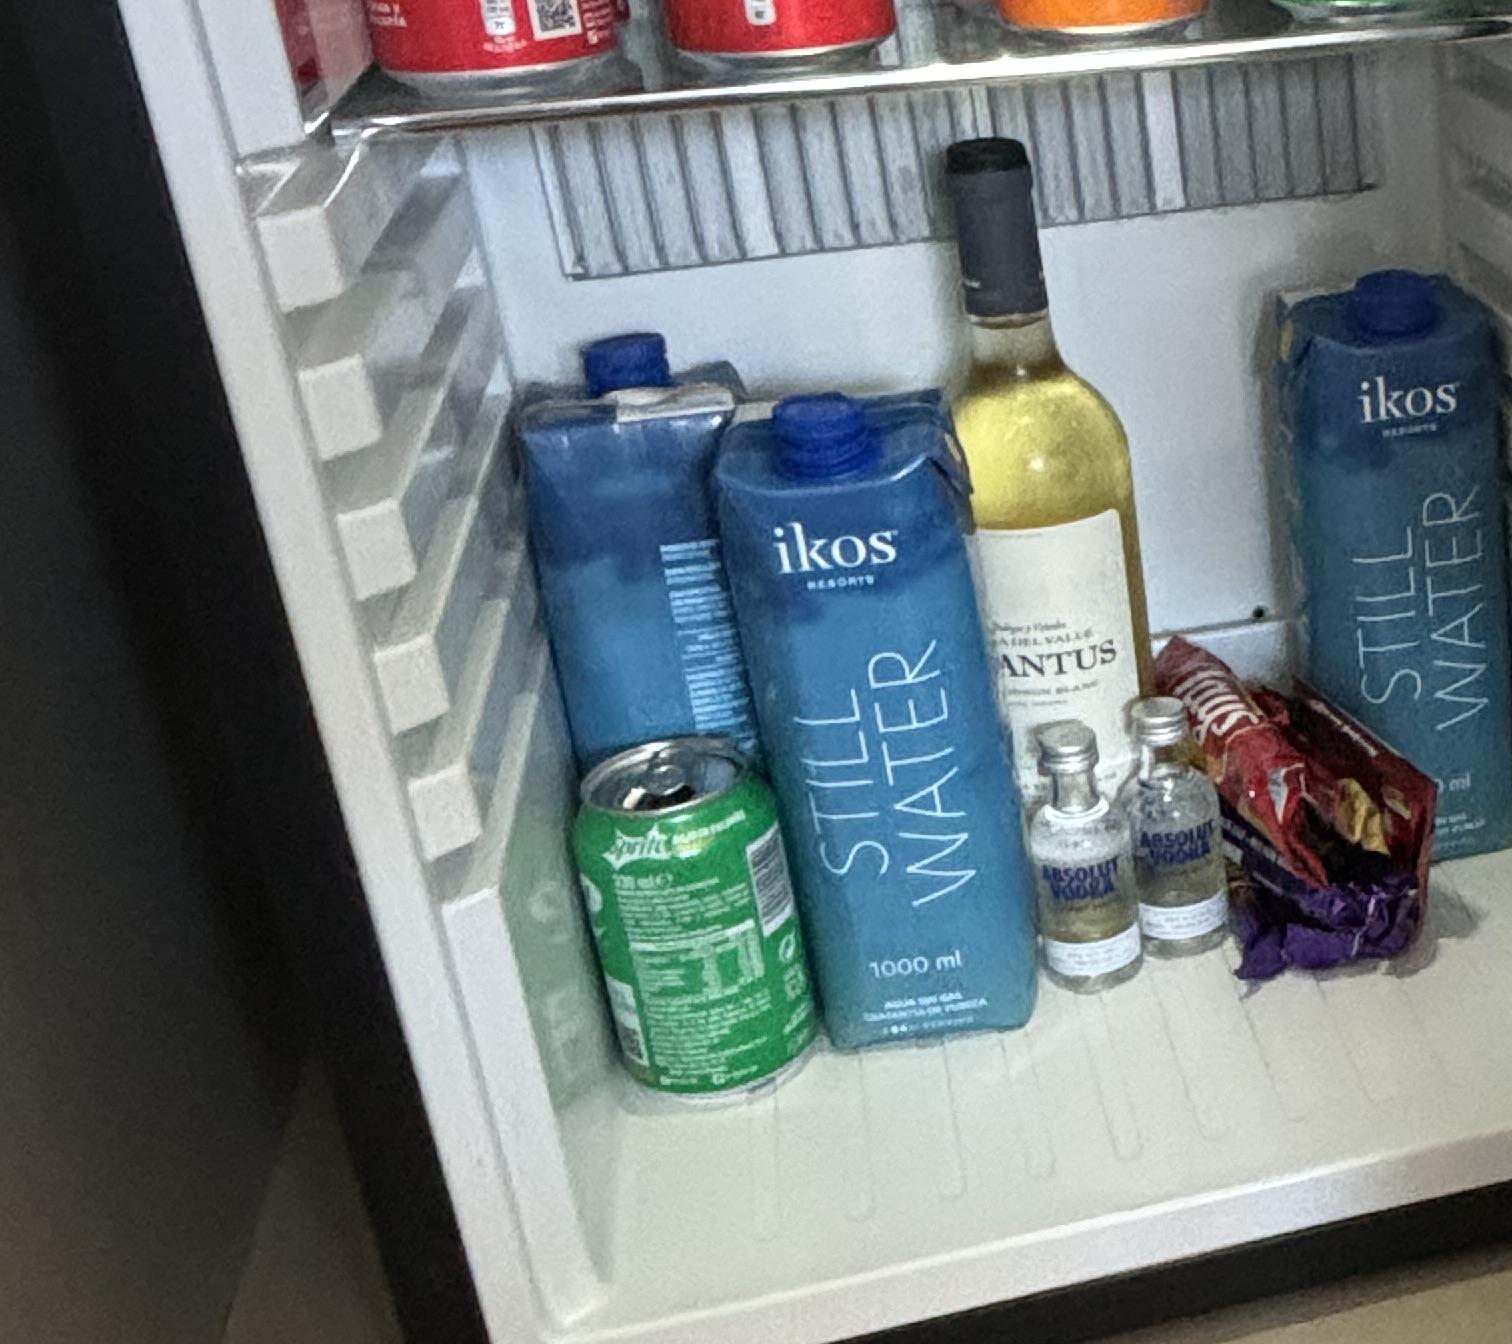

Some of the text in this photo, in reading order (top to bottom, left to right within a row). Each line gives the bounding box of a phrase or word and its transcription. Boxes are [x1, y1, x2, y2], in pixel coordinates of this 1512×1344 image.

[1358, 376, 1458, 424] ikos
[773, 522, 898, 574] ikos
[1353, 527, 1421, 704] STILL
[1423, 485, 1488, 731] WATER
[793, 688, 889, 876] STILL
[868, 638, 979, 908] WATER
[869, 949, 962, 978] 1000 ml
